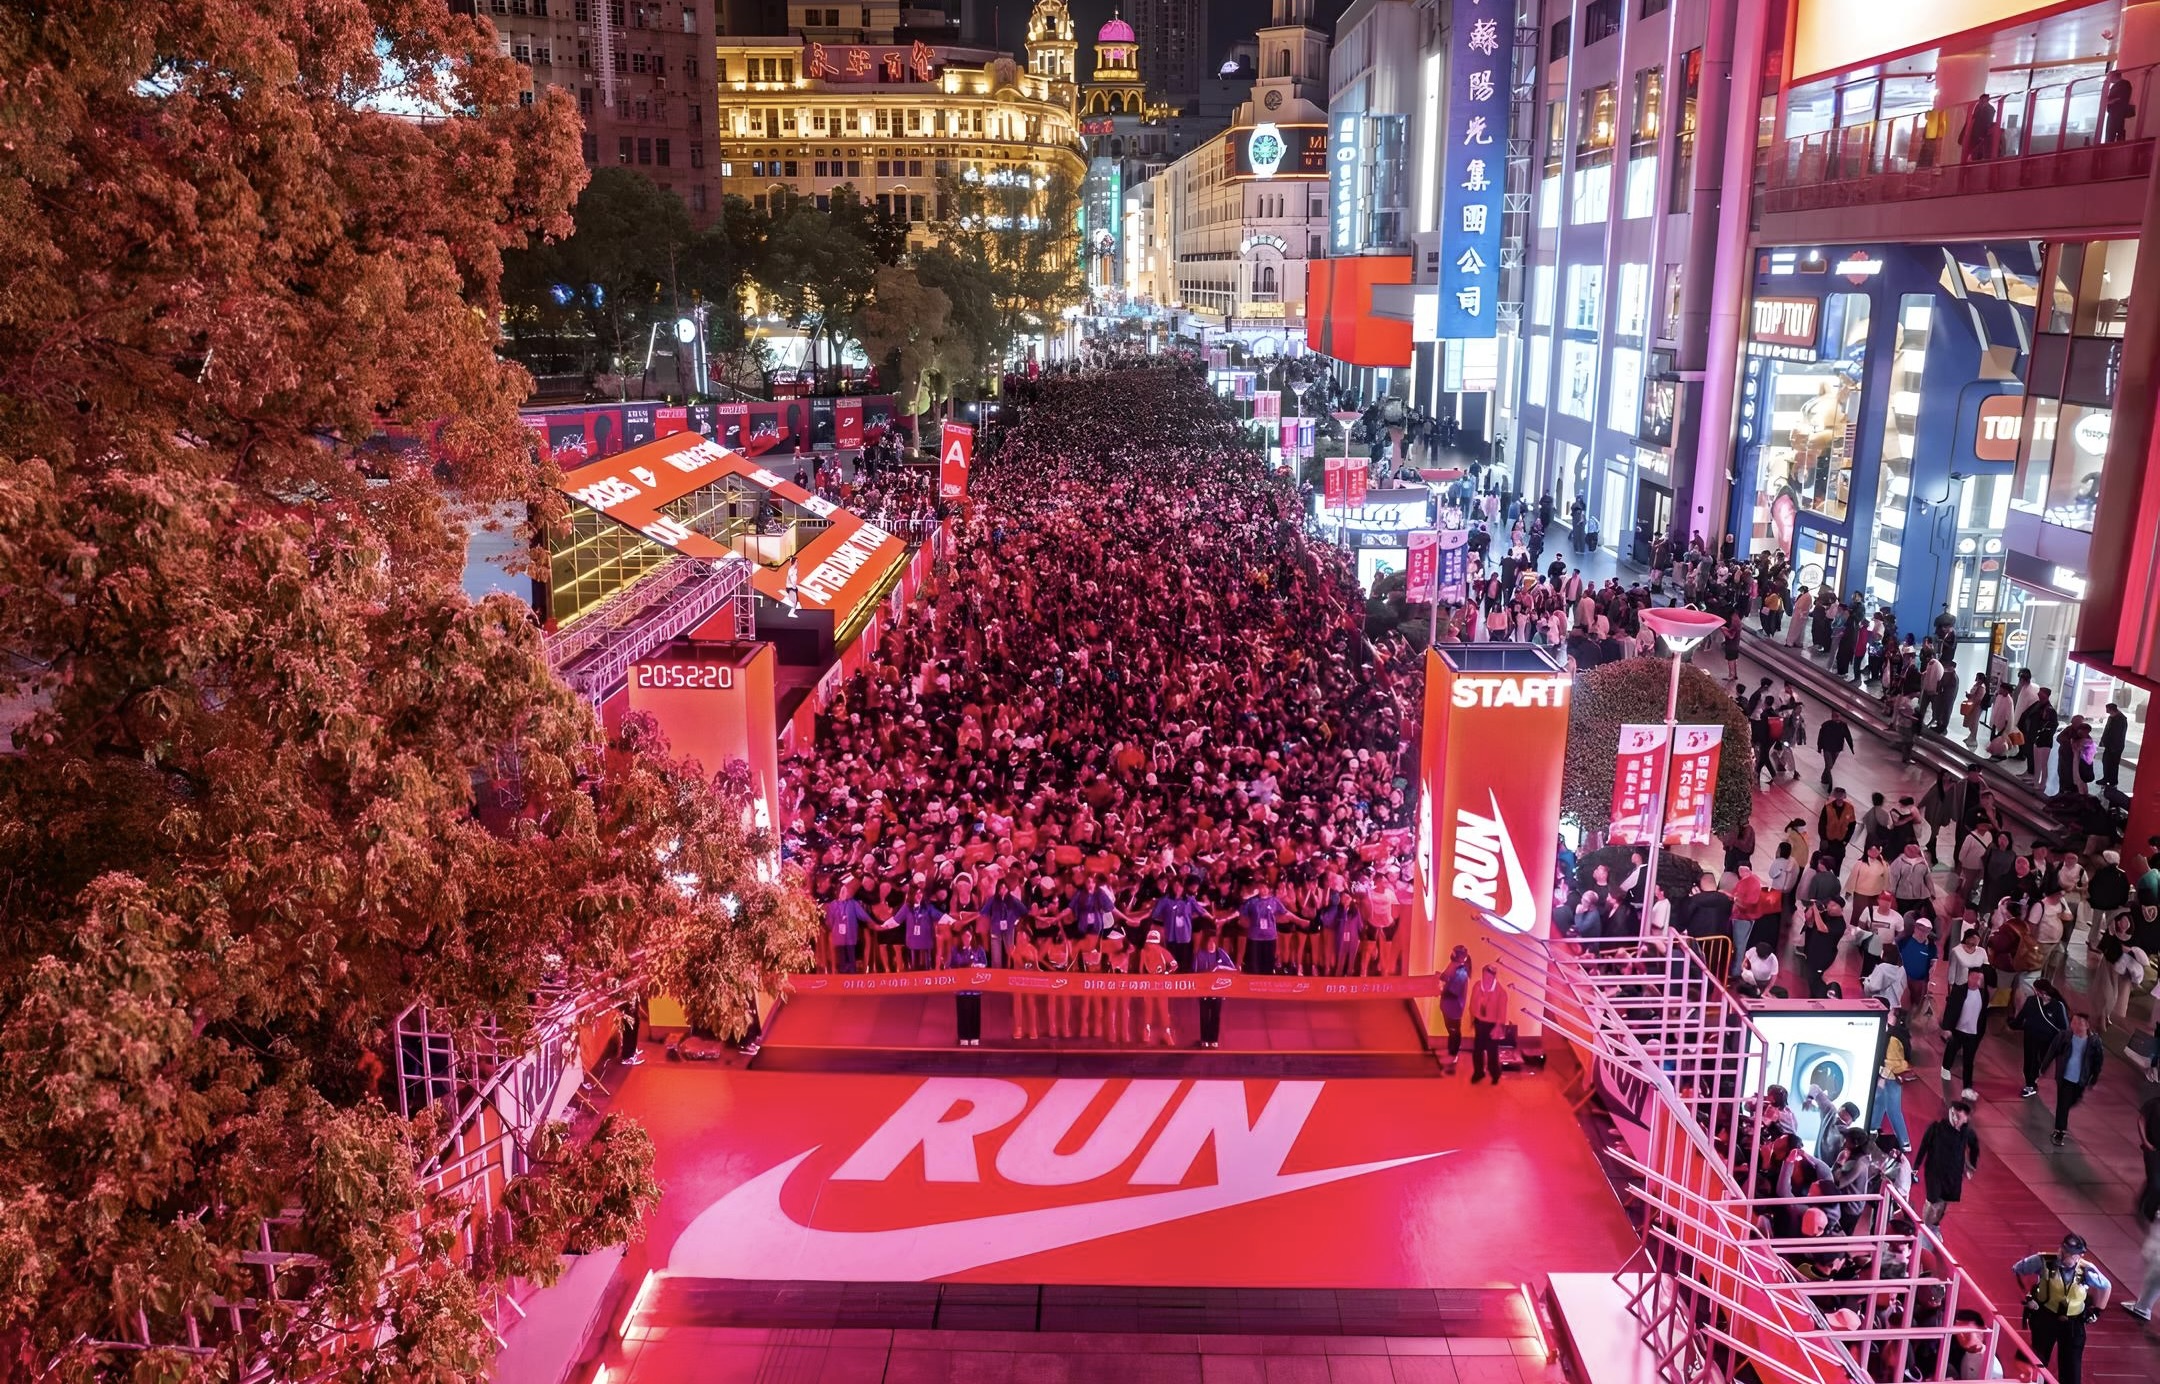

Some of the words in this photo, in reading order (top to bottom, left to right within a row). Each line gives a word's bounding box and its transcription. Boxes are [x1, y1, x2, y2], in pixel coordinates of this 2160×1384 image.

[1457, 0, 1499, 317] 蘇陽光集團公司
[944, 440, 966, 469] A
[640, 664, 732, 688] 20:52:20
[1452, 678, 1573, 708] START
[1451, 808, 1501, 911] RUN
[829, 1076, 1327, 1188] RUN
